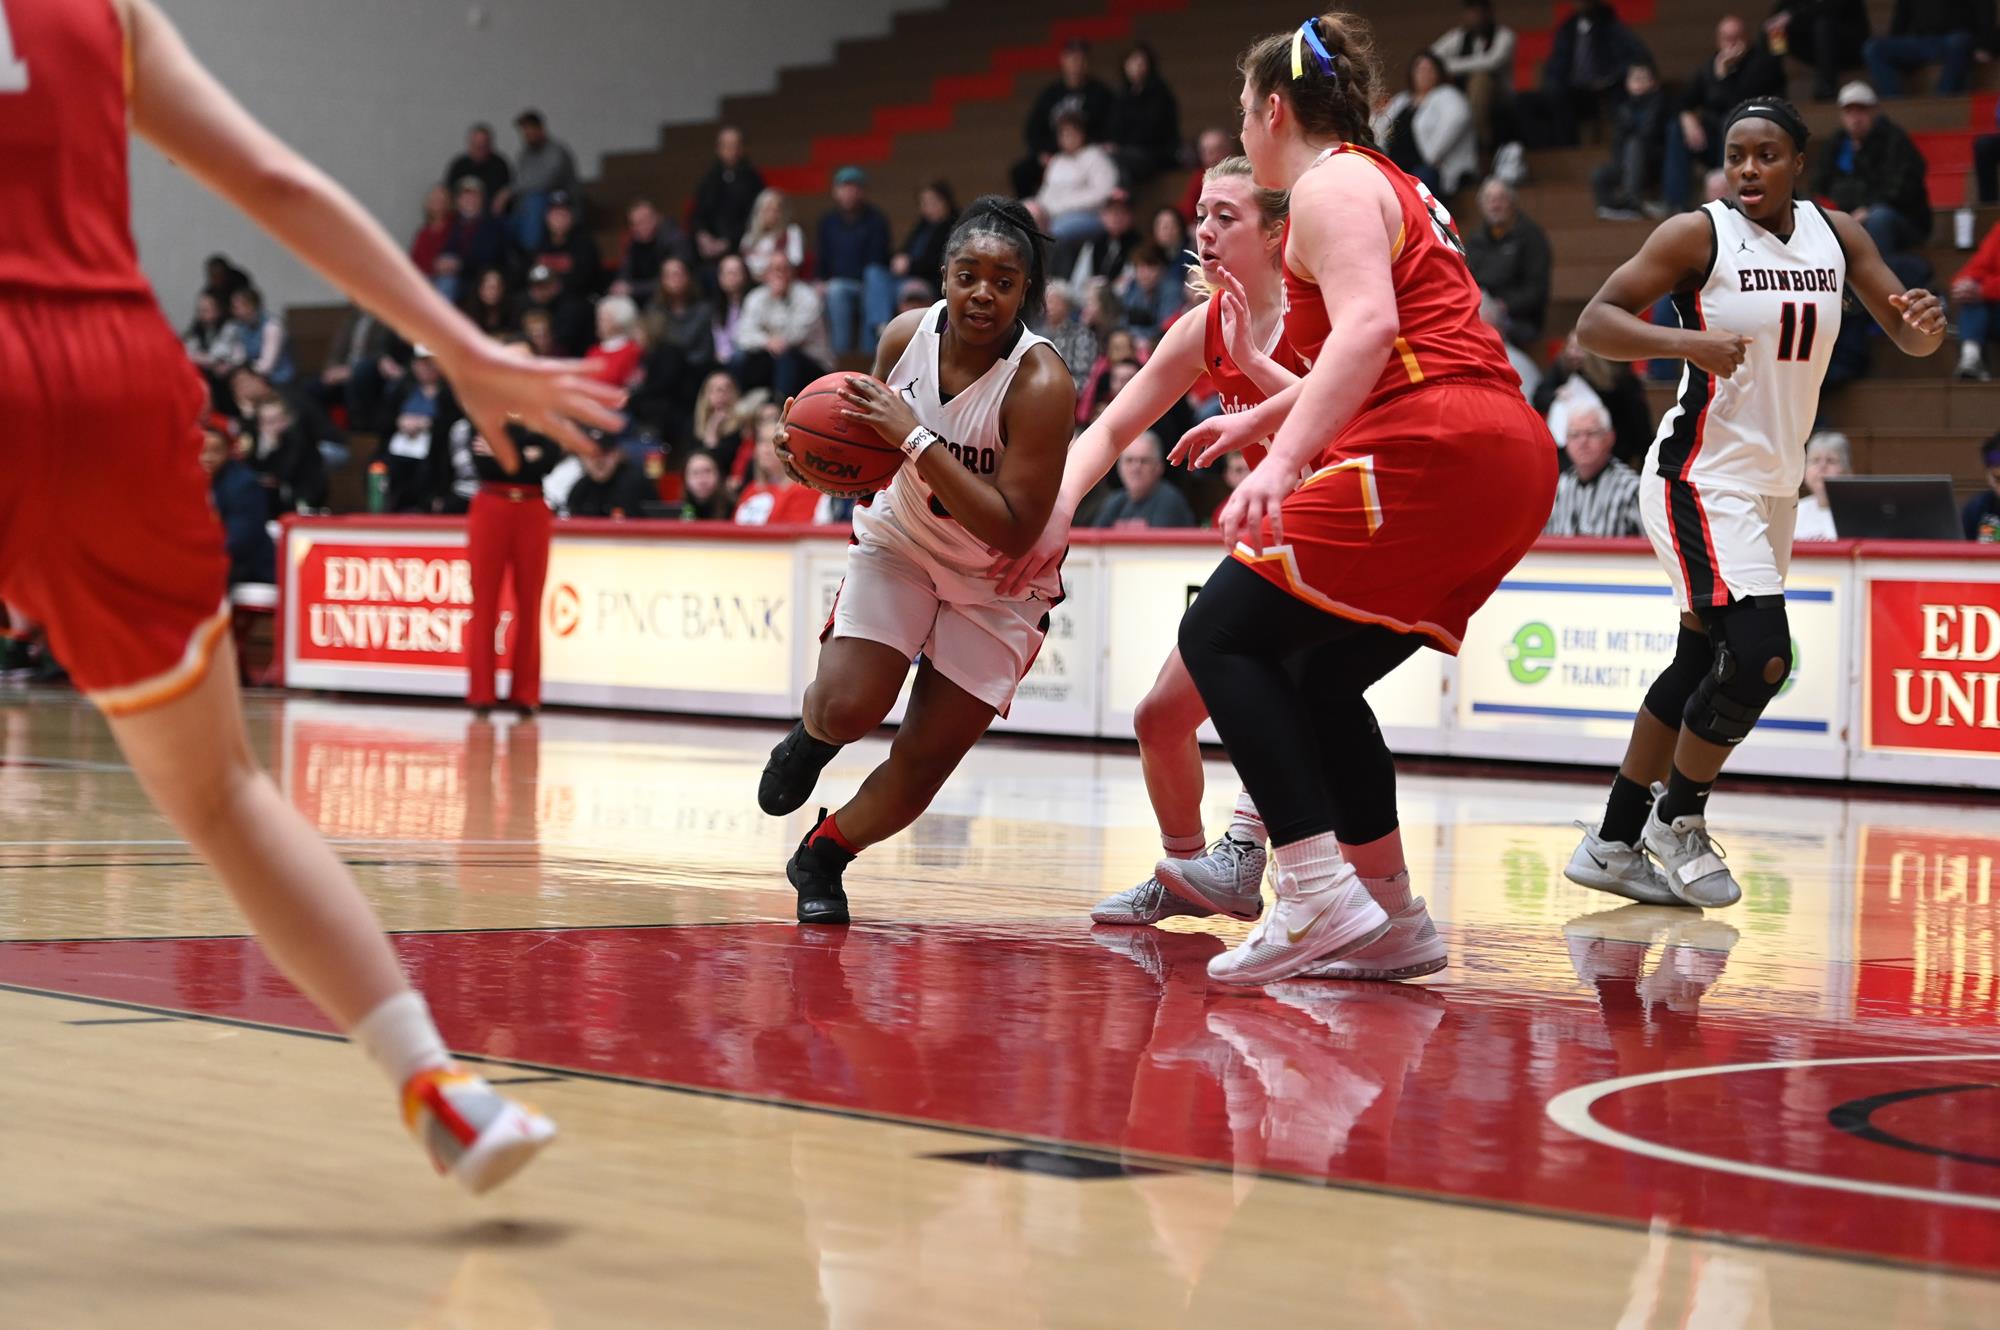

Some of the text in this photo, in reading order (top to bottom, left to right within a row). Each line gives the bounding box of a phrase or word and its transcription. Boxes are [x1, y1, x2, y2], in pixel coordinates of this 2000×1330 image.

[1738, 268, 1837, 292] EDINBORO
[1776, 301, 1817, 362] 11
[804, 449, 863, 480] NCAA
[324, 556, 475, 605] EDINBOR
[597, 588, 674, 638] PNC
[681, 592, 786, 643] BANK
[1562, 627, 1677, 655] ERIE METROP
[1561, 664, 1630, 687] TRANSIT
